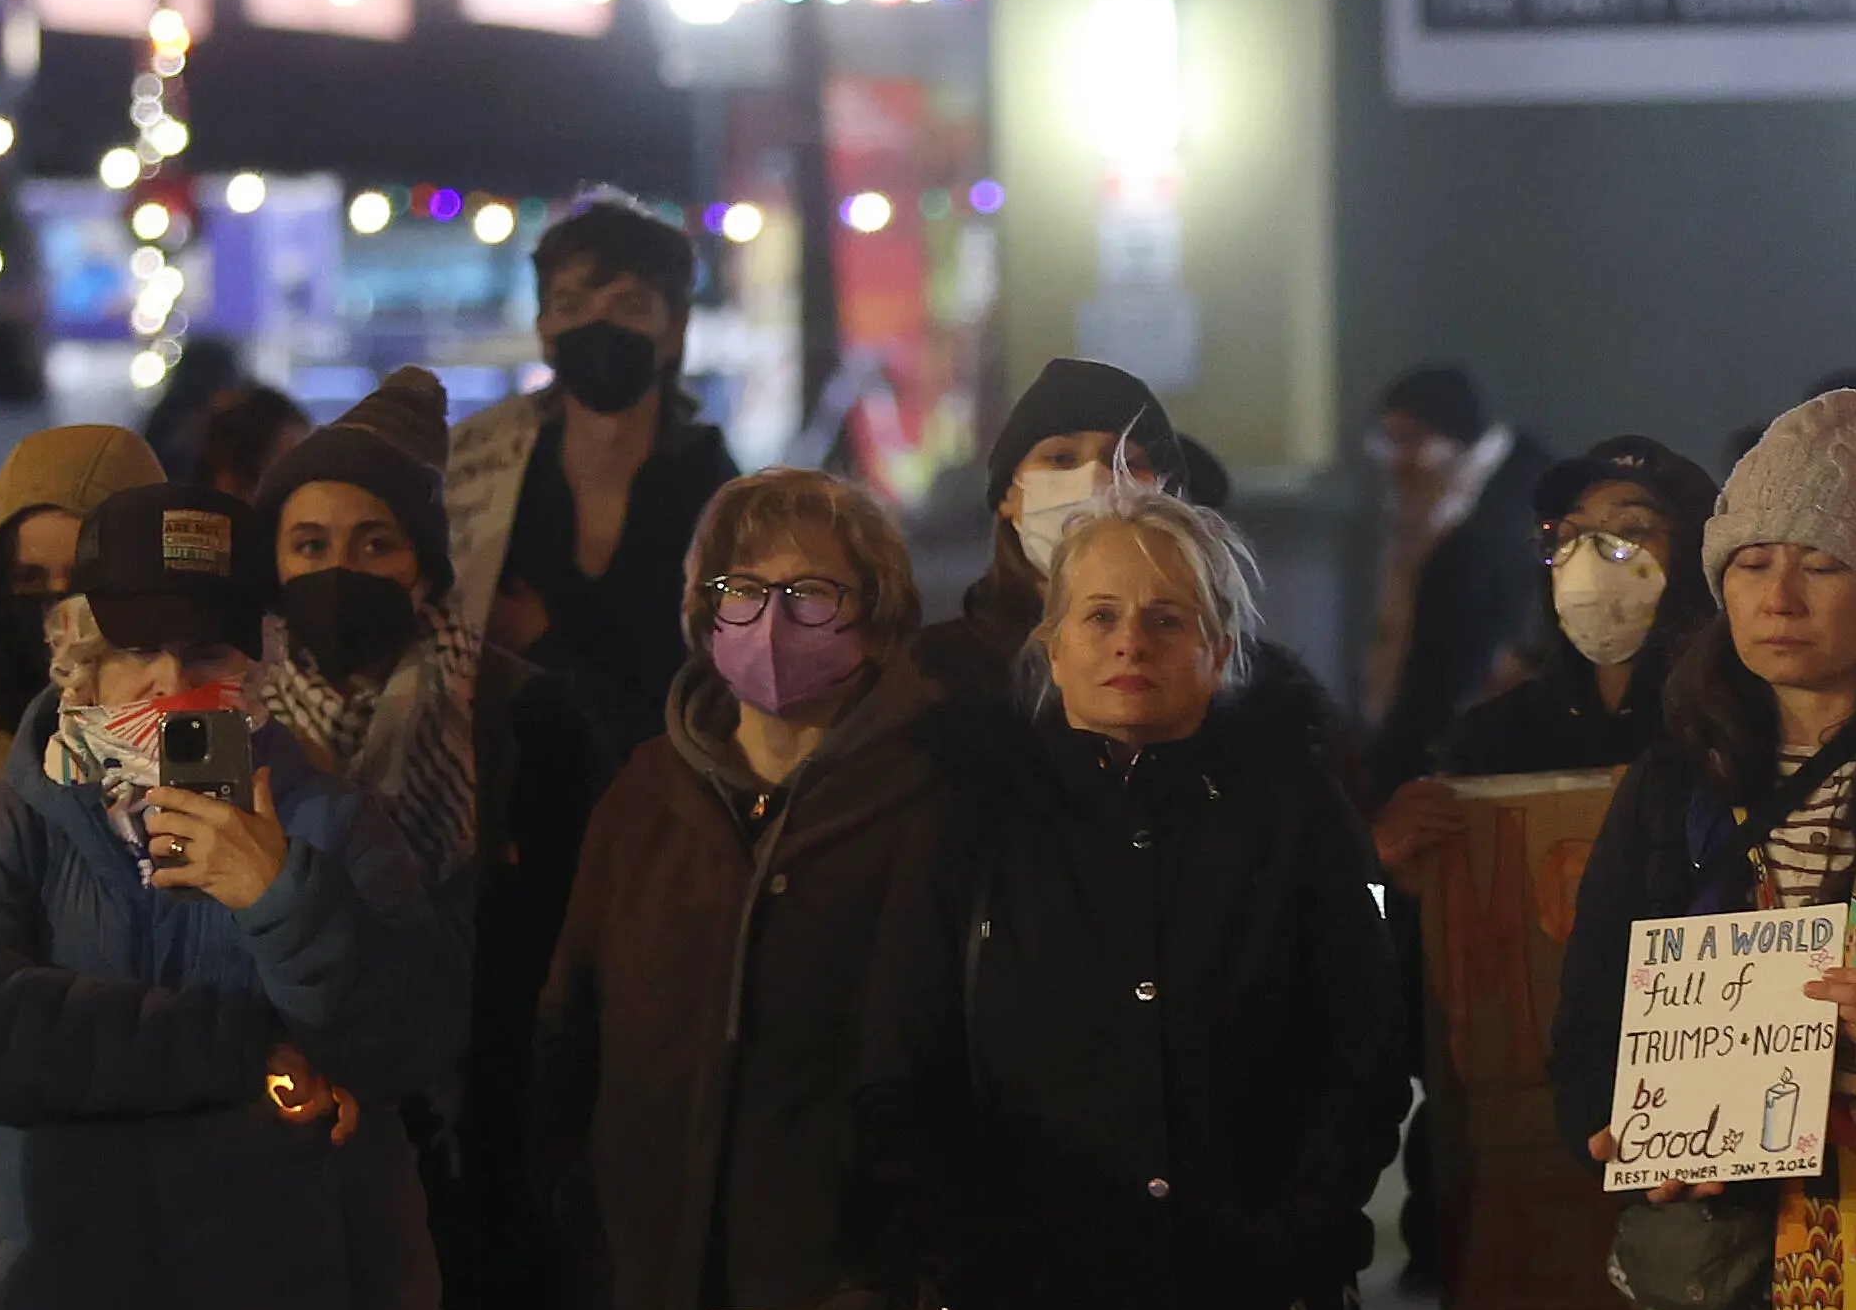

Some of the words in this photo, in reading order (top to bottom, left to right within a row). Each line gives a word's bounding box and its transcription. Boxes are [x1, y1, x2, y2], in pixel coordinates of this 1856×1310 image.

[1644, 927, 1684, 966] IN
[1697, 925, 1717, 961] A
[1731, 917, 1834, 956] WORLD
[1642, 971, 1707, 1017] full
[1721, 962, 1756, 1011] of
[1626, 1025, 1734, 1066] TRUMPS
[1752, 1021, 1835, 1057] NOEMS
[1632, 1077, 1667, 1110] be
[1616, 1104, 1722, 1164] Good
[1614, 1170, 1649, 1185] REST
[1654, 1168, 1669, 1182] IN
[1675, 1165, 1718, 1180] POWER
[1730, 1163, 1756, 1177] JAN
[1776, 1158, 1818, 1173] 2026
